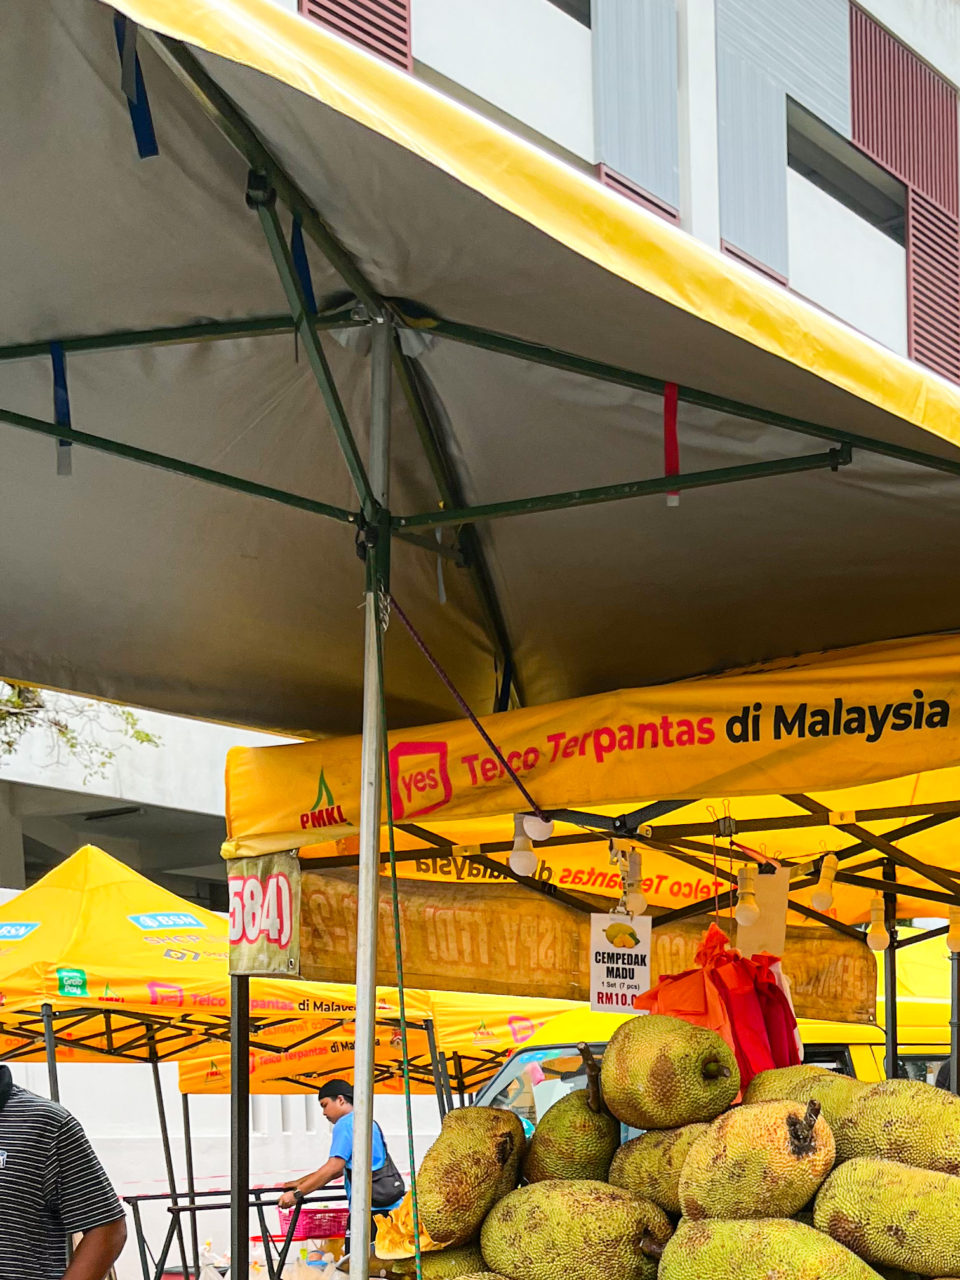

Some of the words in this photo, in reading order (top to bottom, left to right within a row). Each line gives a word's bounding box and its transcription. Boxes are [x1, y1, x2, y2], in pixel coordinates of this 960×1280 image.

[461, 746, 541, 786] Telco
[547, 716, 715, 763] Terpantas
[725, 702, 762, 744] di
[773, 689, 950, 743] Malaysia
[401, 768, 439, 804] yes
[300, 805, 348, 830] PMKL
[595, 951, 647, 967] CEMPEDAK
[606, 966, 635, 980] MADU
[627, 983, 640, 991] pcs)
[190, 994, 227, 1007] Telco
[298, 999, 309, 1011] di
